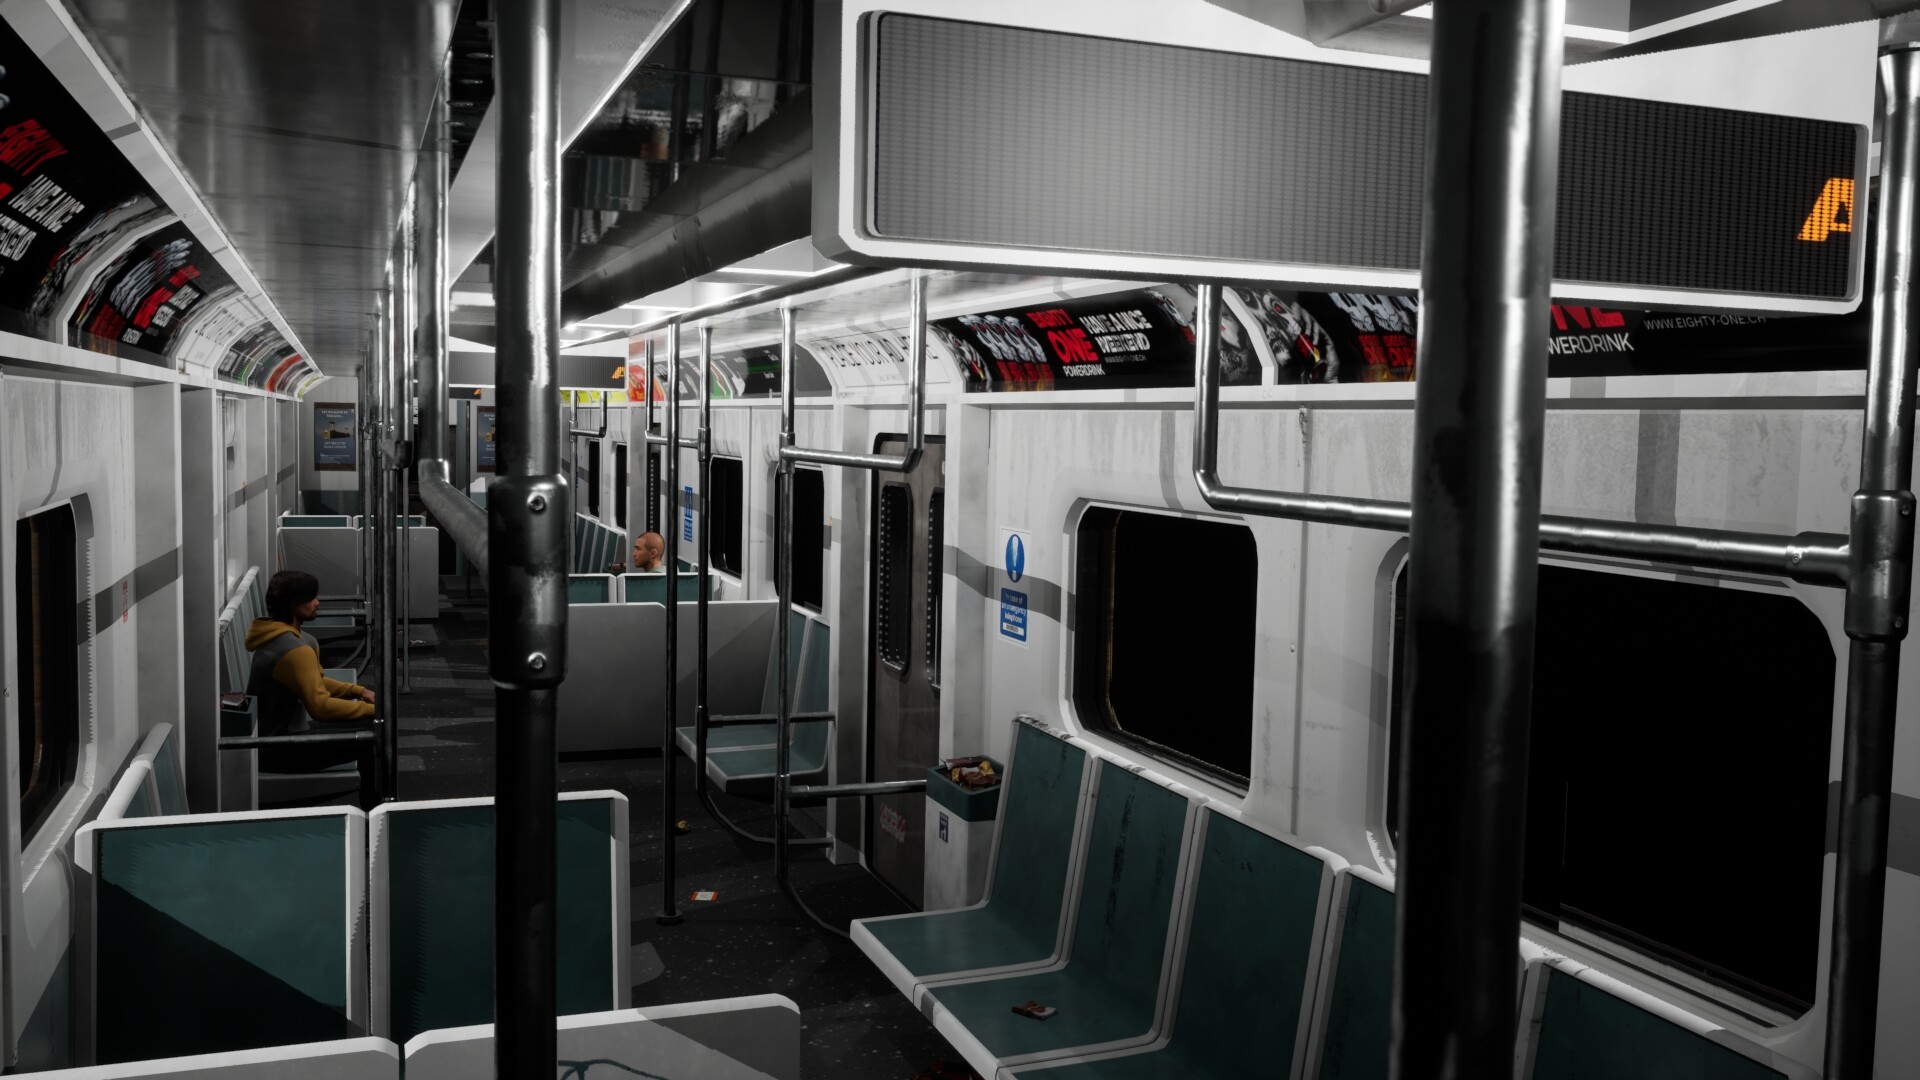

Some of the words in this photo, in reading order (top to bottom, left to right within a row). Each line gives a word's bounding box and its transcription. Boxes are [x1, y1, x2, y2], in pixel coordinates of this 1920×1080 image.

[7, 173, 62, 218] HAVE
[31, 191, 68, 222] A
[38, 195, 86, 233] NICE
[1026, 308, 1074, 329] EIGHTY
[1079, 314, 1118, 335] HAVE
[1108, 312, 1127, 332] A
[1115, 309, 1153, 331] NICE
[819, 343, 862, 369] PLACE
[846, 339, 890, 366] YOUR
[1046, 328, 1099, 364] ONE
[1094, 332, 1151, 354] WEEKEND
[1548, 332, 1635, 355] WERDRINK
[1062, 363, 1106, 377] POWERDRINK
